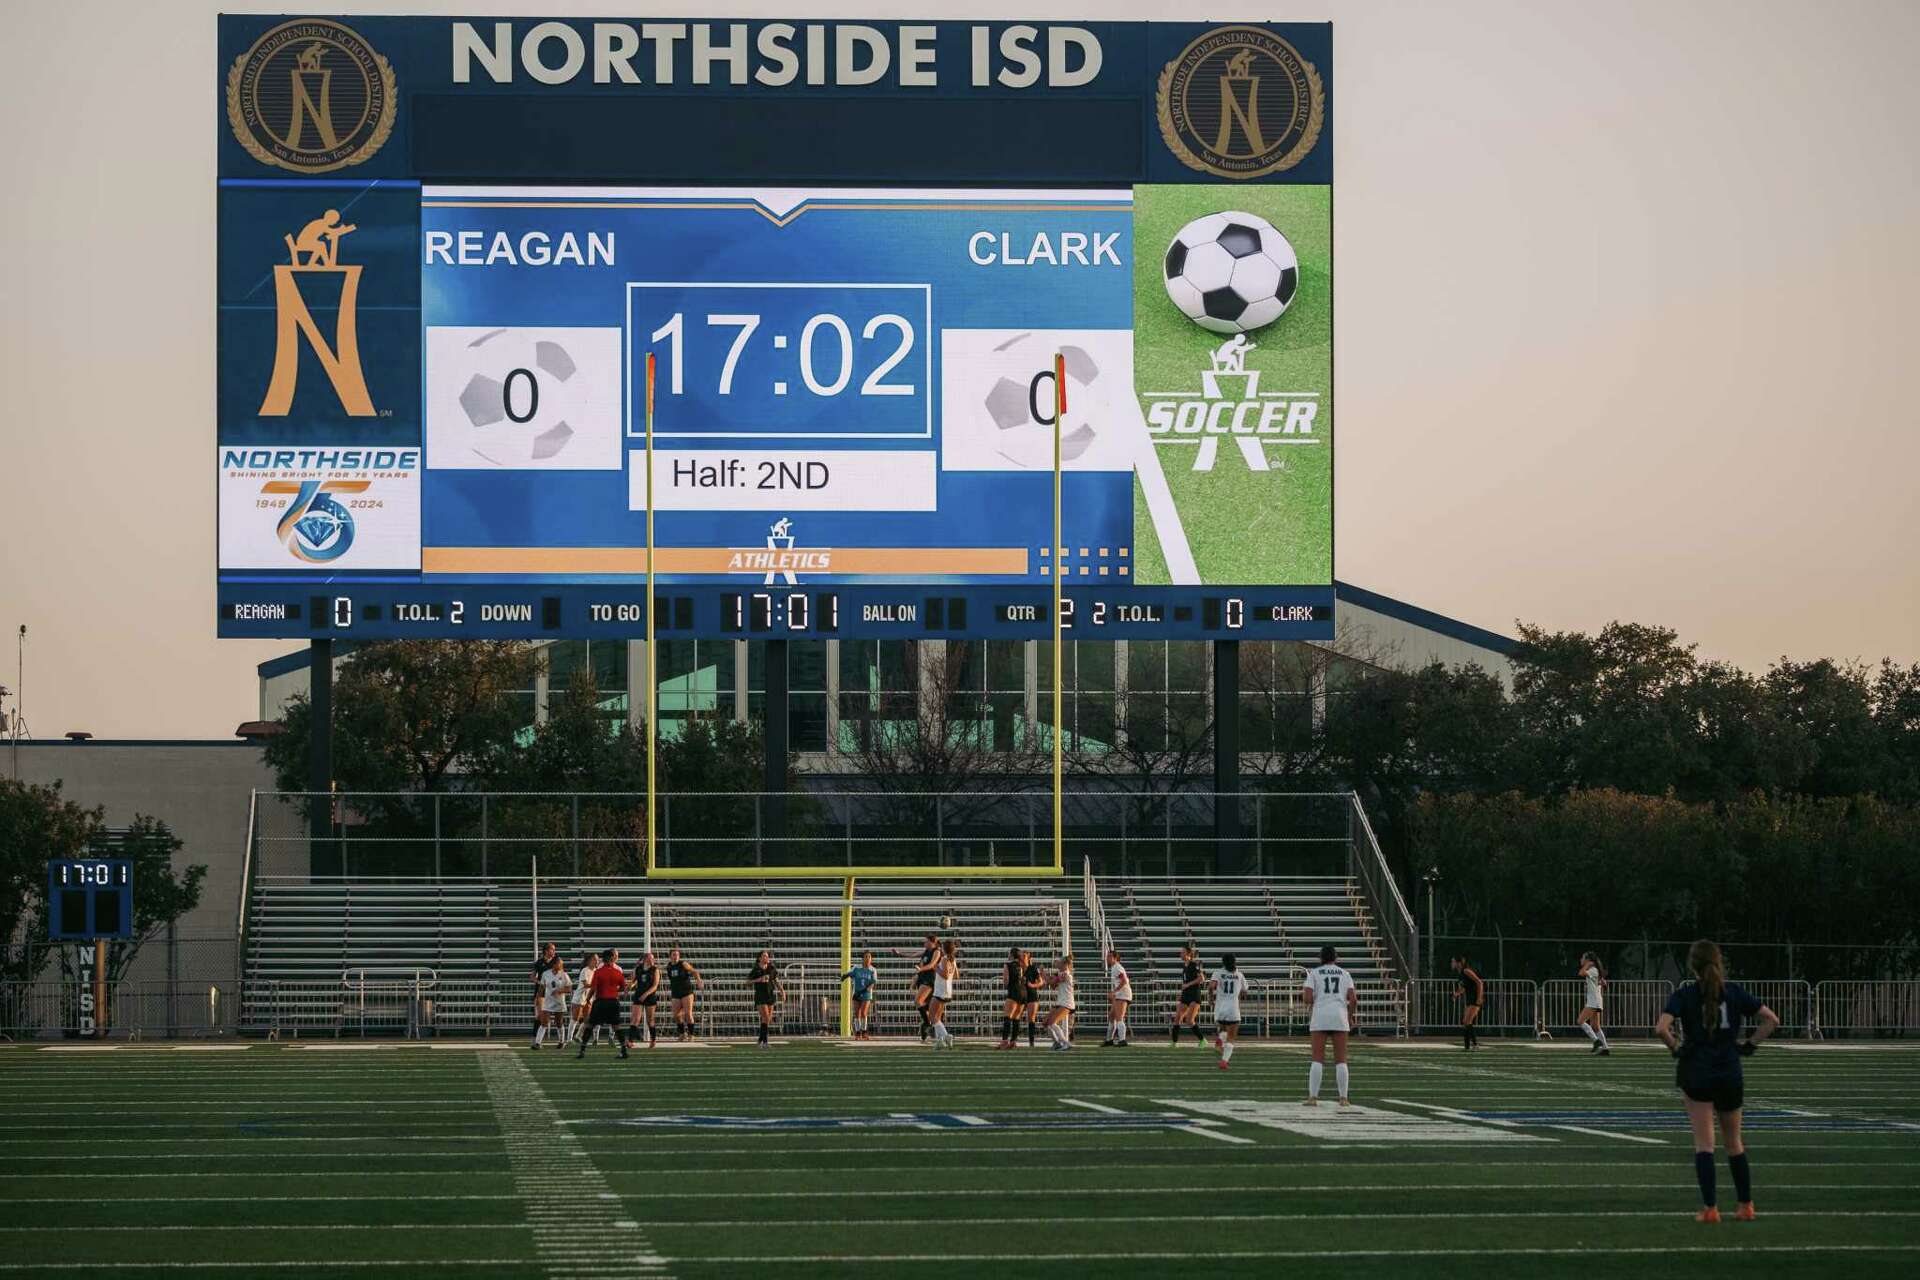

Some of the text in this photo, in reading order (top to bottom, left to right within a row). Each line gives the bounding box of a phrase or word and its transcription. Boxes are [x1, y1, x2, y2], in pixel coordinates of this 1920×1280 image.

[451, 21, 1104, 89] NORTHSIDE ISD
[257, 26, 336, 61] INDEPENDENT
[337, 31, 374, 70] SCHOOL
[366, 72, 382, 128] DISTRICT
[1187, 32, 1264, 67] INDEPENDENT
[1263, 36, 1301, 78] SCHOOL
[1294, 79, 1309, 132] DISTRICT
[271, 142, 287, 158] San
[332, 144, 356, 160] Texas
[1200, 149, 1217, 164] San
[1260, 149, 1284, 164] Texas
[424, 230, 616, 267] REAGAN
[968, 231, 1122, 267] CLARK
[651, 312, 916, 398] 17:02
[502, 367, 540, 424] 0
[1146, 400, 1319, 434] SOCCER
[223, 451, 420, 469] NORTHSIDE
[673, 459, 831, 490] Half: 2ND
[255, 499, 287, 509] 1949
[350, 499, 384, 509] 2024
[728, 552, 831, 569] ATHLETICS
[235, 604, 285, 620] REAGAN
[334, 597, 352, 627] 0
[396, 604, 440, 622] T.O.L.
[450, 601, 465, 625] 2
[481, 604, 532, 622] DOWN
[590, 604, 641, 622] TO GO
[736, 593, 838, 630] 17:01
[863, 605, 916, 622] BALL ON
[1007, 605, 1036, 622] QTR
[1093, 601, 1106, 625] 2
[1118, 605, 1161, 623] T.O.L.
[1226, 598, 1244, 629] 0
[1272, 605, 1313, 622] CLARK
[61, 864, 127, 885] 17:01
[79, 946, 97, 1036] NISD
[1223, 980, 1234, 994] 11
[1324, 976, 1340, 994] 17
